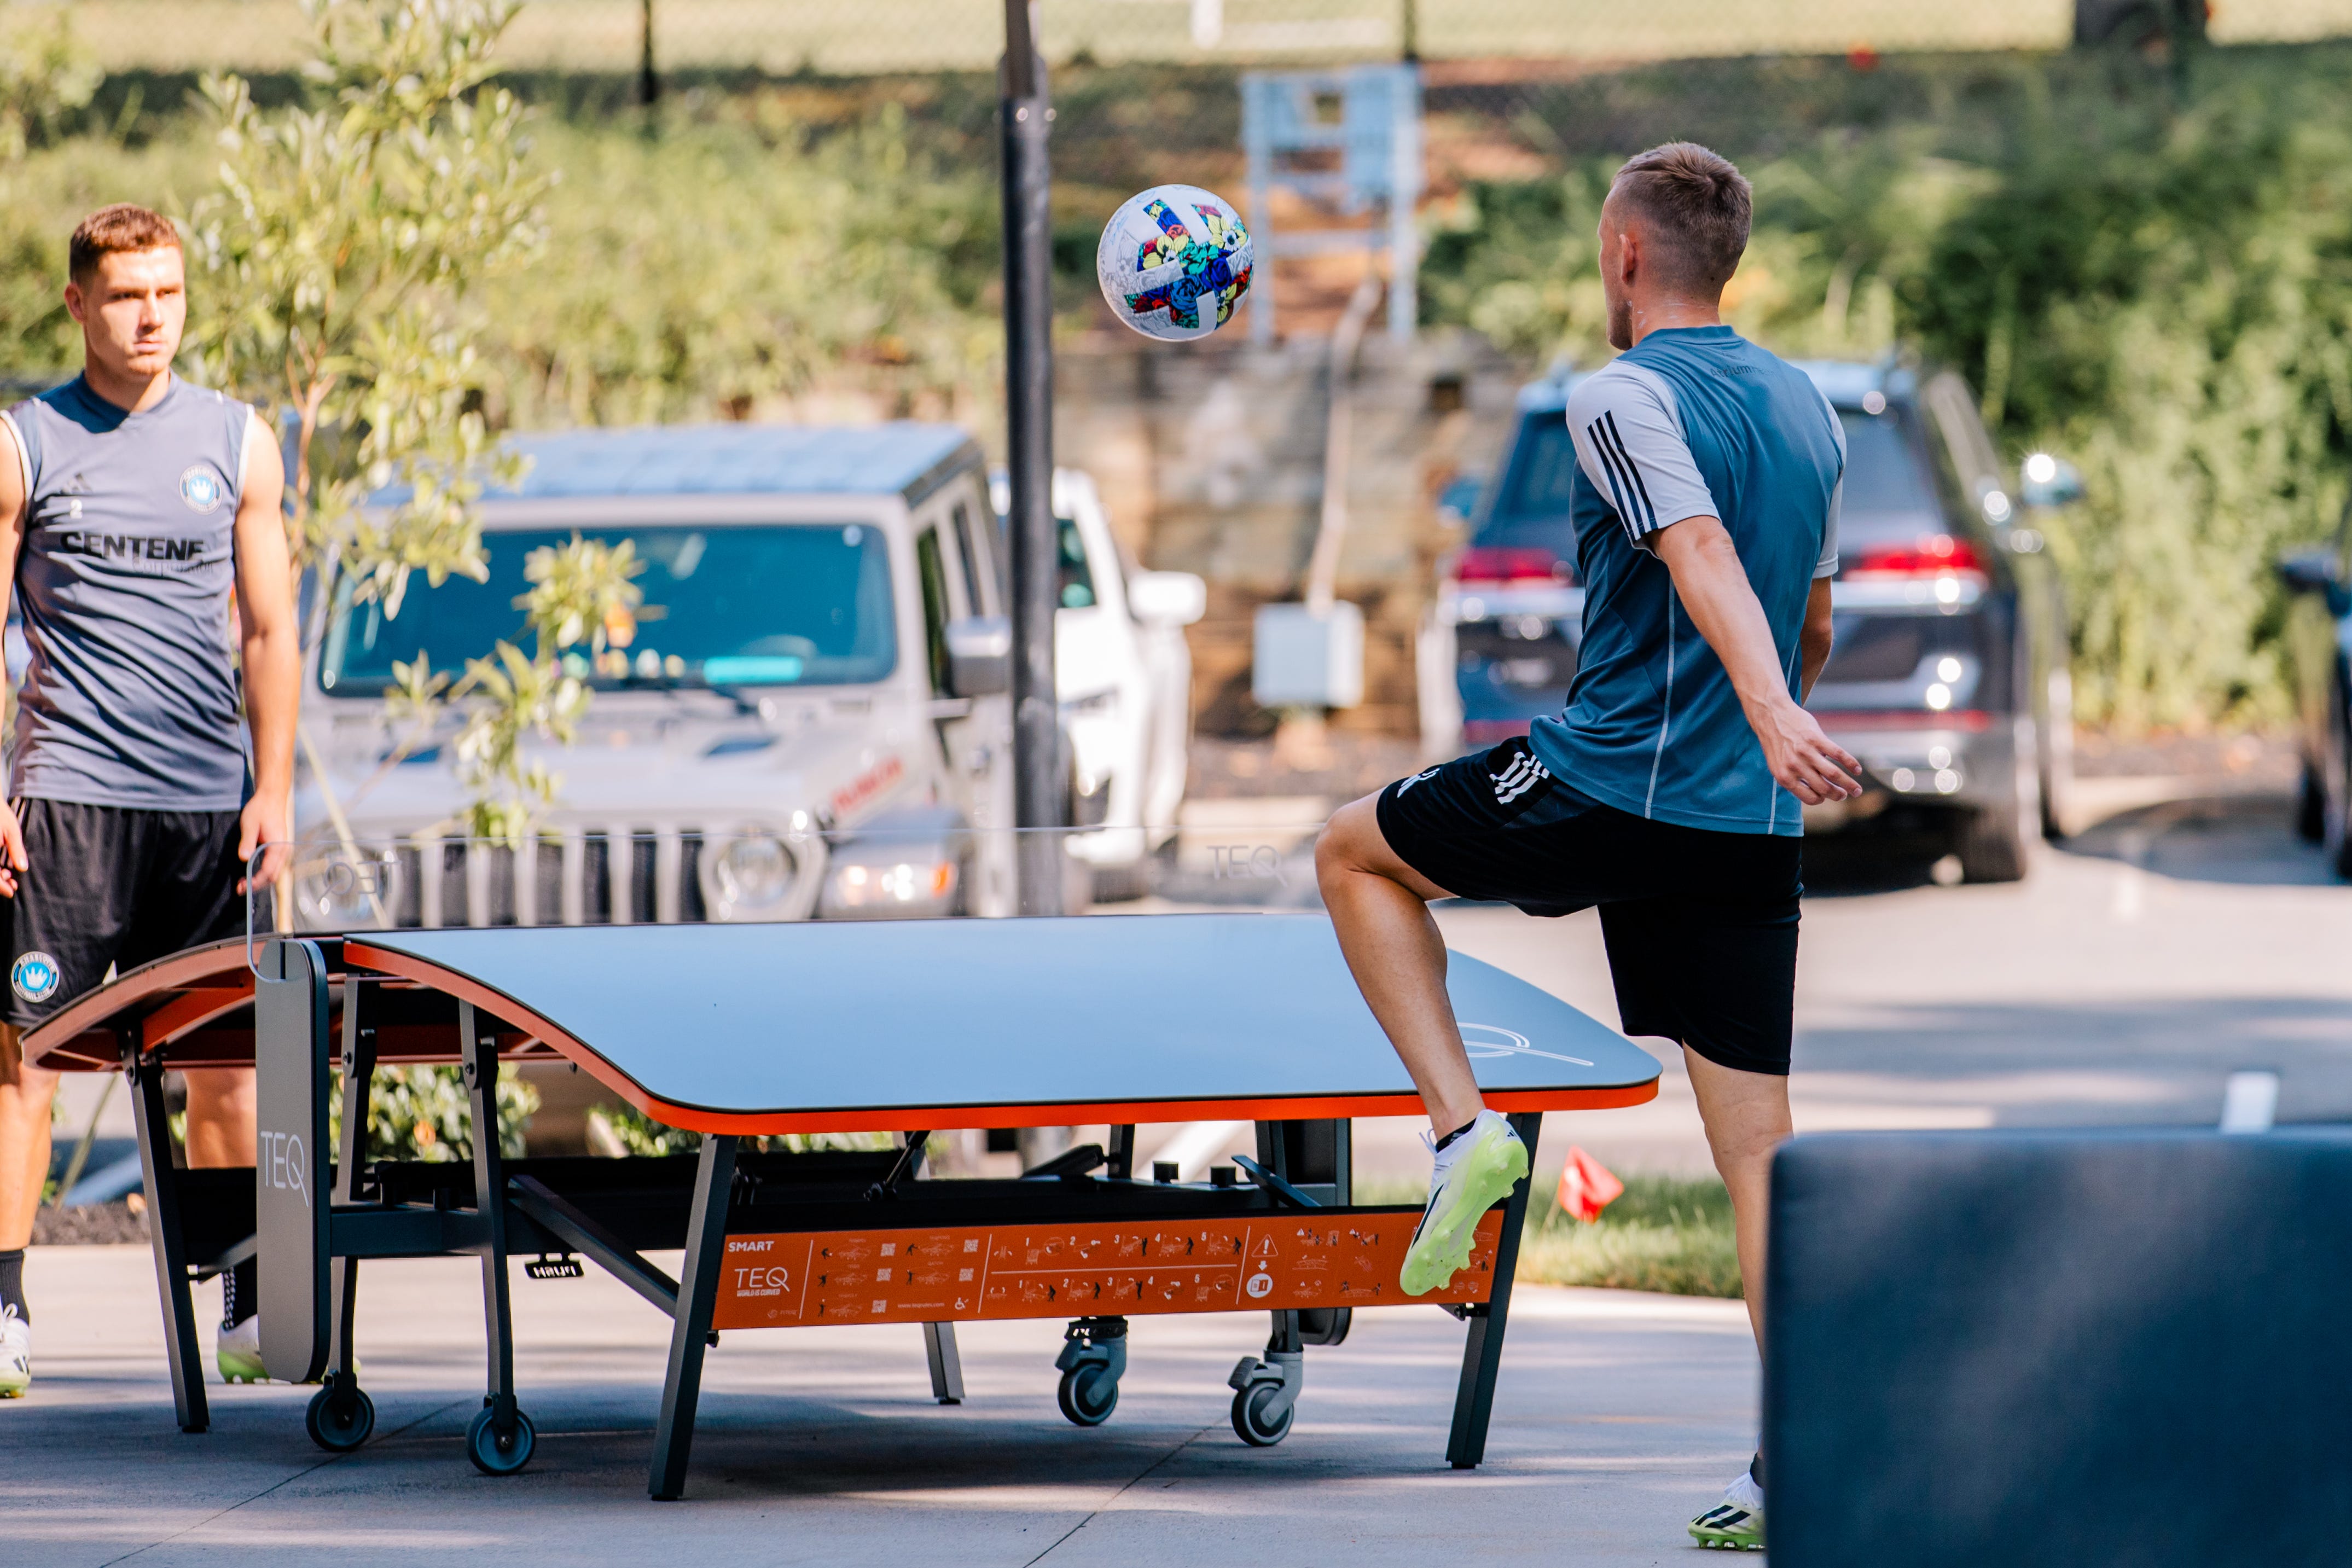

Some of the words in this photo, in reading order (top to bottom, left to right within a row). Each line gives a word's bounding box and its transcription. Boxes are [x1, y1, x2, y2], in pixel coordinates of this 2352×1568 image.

[69, 498, 83, 519] 2
[1206, 845, 1288, 888] TEQ
[260, 1131, 309, 1207] TEQ
[728, 1241, 775, 1252] SMART
[1025, 1237, 1030, 1247] 1
[1070, 1235, 1076, 1246] 2
[1114, 1234, 1120, 1244] 3
[1155, 1233, 1161, 1242] 4
[1201, 1232, 1207, 1241] 5
[734, 1267, 791, 1292] TEQ
[1018, 1280, 1023, 1289] 1
[1063, 1278, 1069, 1288] 2
[1107, 1276, 1113, 1286] 3
[1148, 1275, 1154, 1285] 4
[760, 1288, 781, 1296] CURVED
